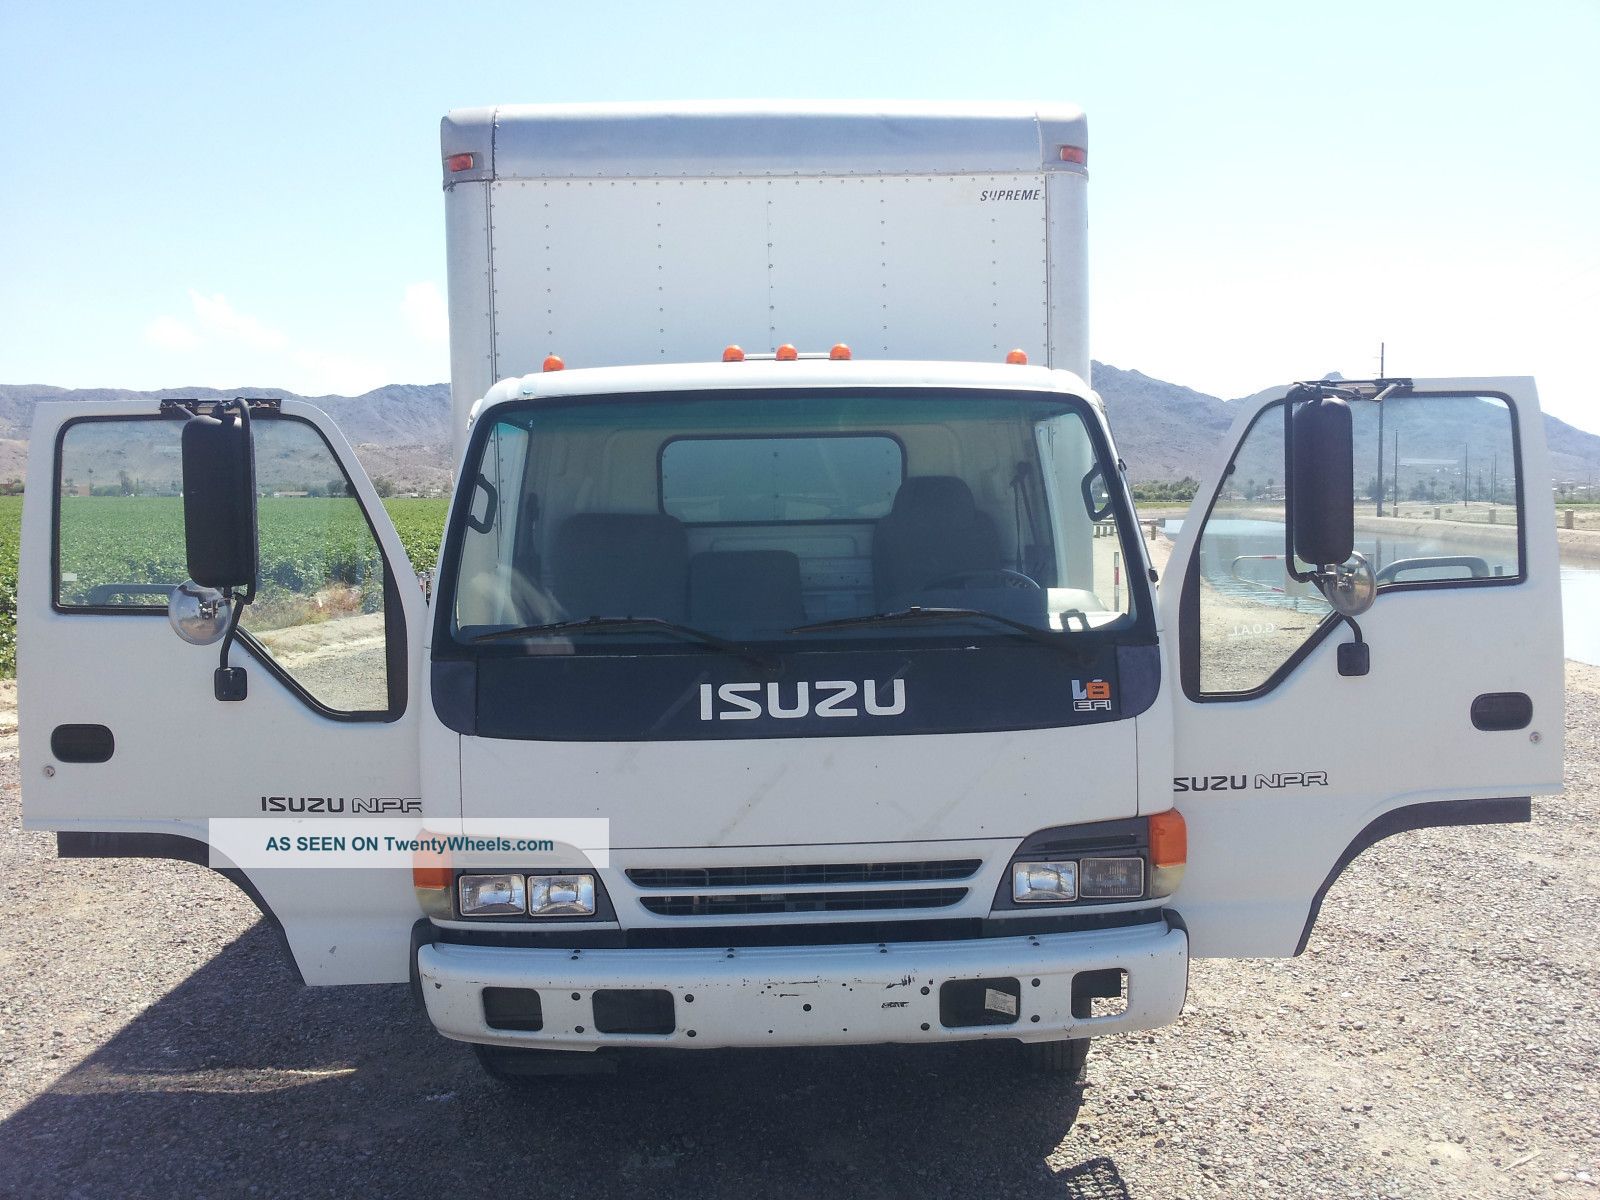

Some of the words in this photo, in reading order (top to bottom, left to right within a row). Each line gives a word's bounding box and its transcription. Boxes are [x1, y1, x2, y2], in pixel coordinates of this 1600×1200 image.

[980, 189, 1041, 202] SUPREME
[700, 678, 906, 721] ISUZU
[1173, 775, 1247, 792] SUZU
[1254, 770, 1328, 789] NPR
[261, 796, 345, 813] ISUZU
